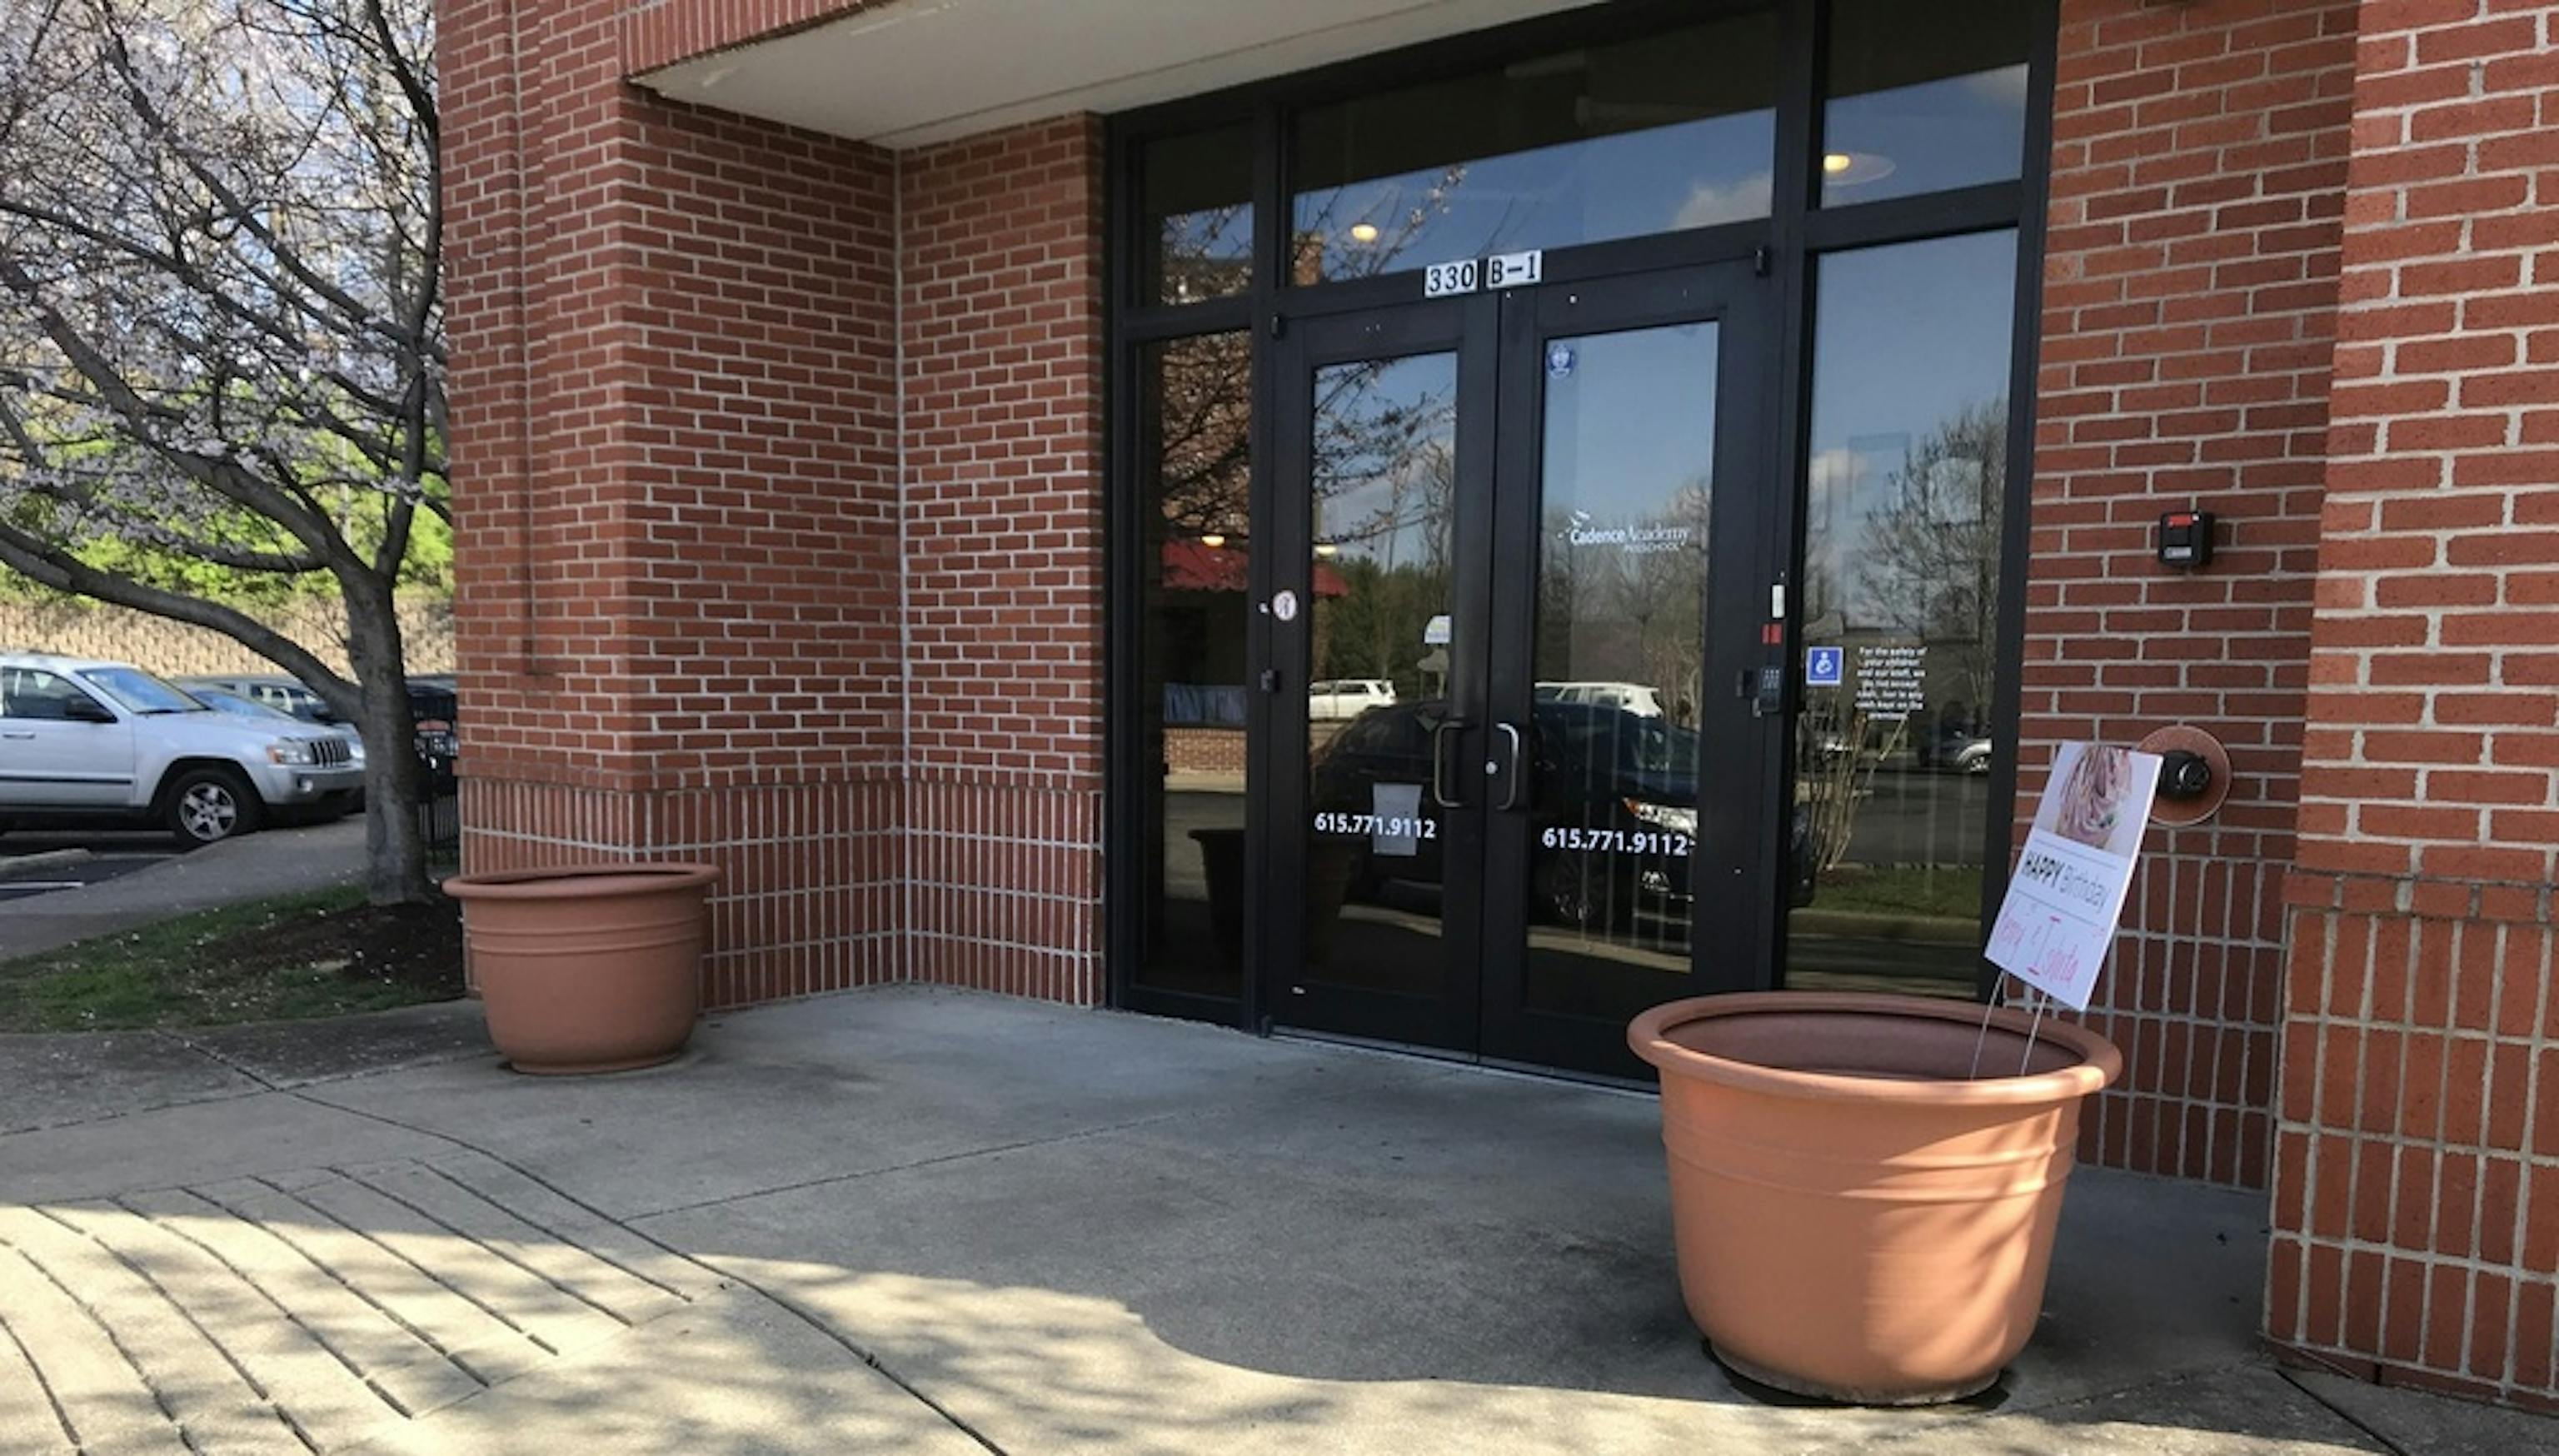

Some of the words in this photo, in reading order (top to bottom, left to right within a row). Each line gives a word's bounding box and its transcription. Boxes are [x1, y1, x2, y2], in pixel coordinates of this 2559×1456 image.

[1429, 263, 1474, 292] 330
[1492, 253, 1535, 284] B-1
[1314, 812, 1436, 838] 615.771.9112
[1542, 828, 1688, 855] 615.771.9112
[2022, 850, 2065, 888] HAPPY
[2059, 864, 2112, 914] Birthday
